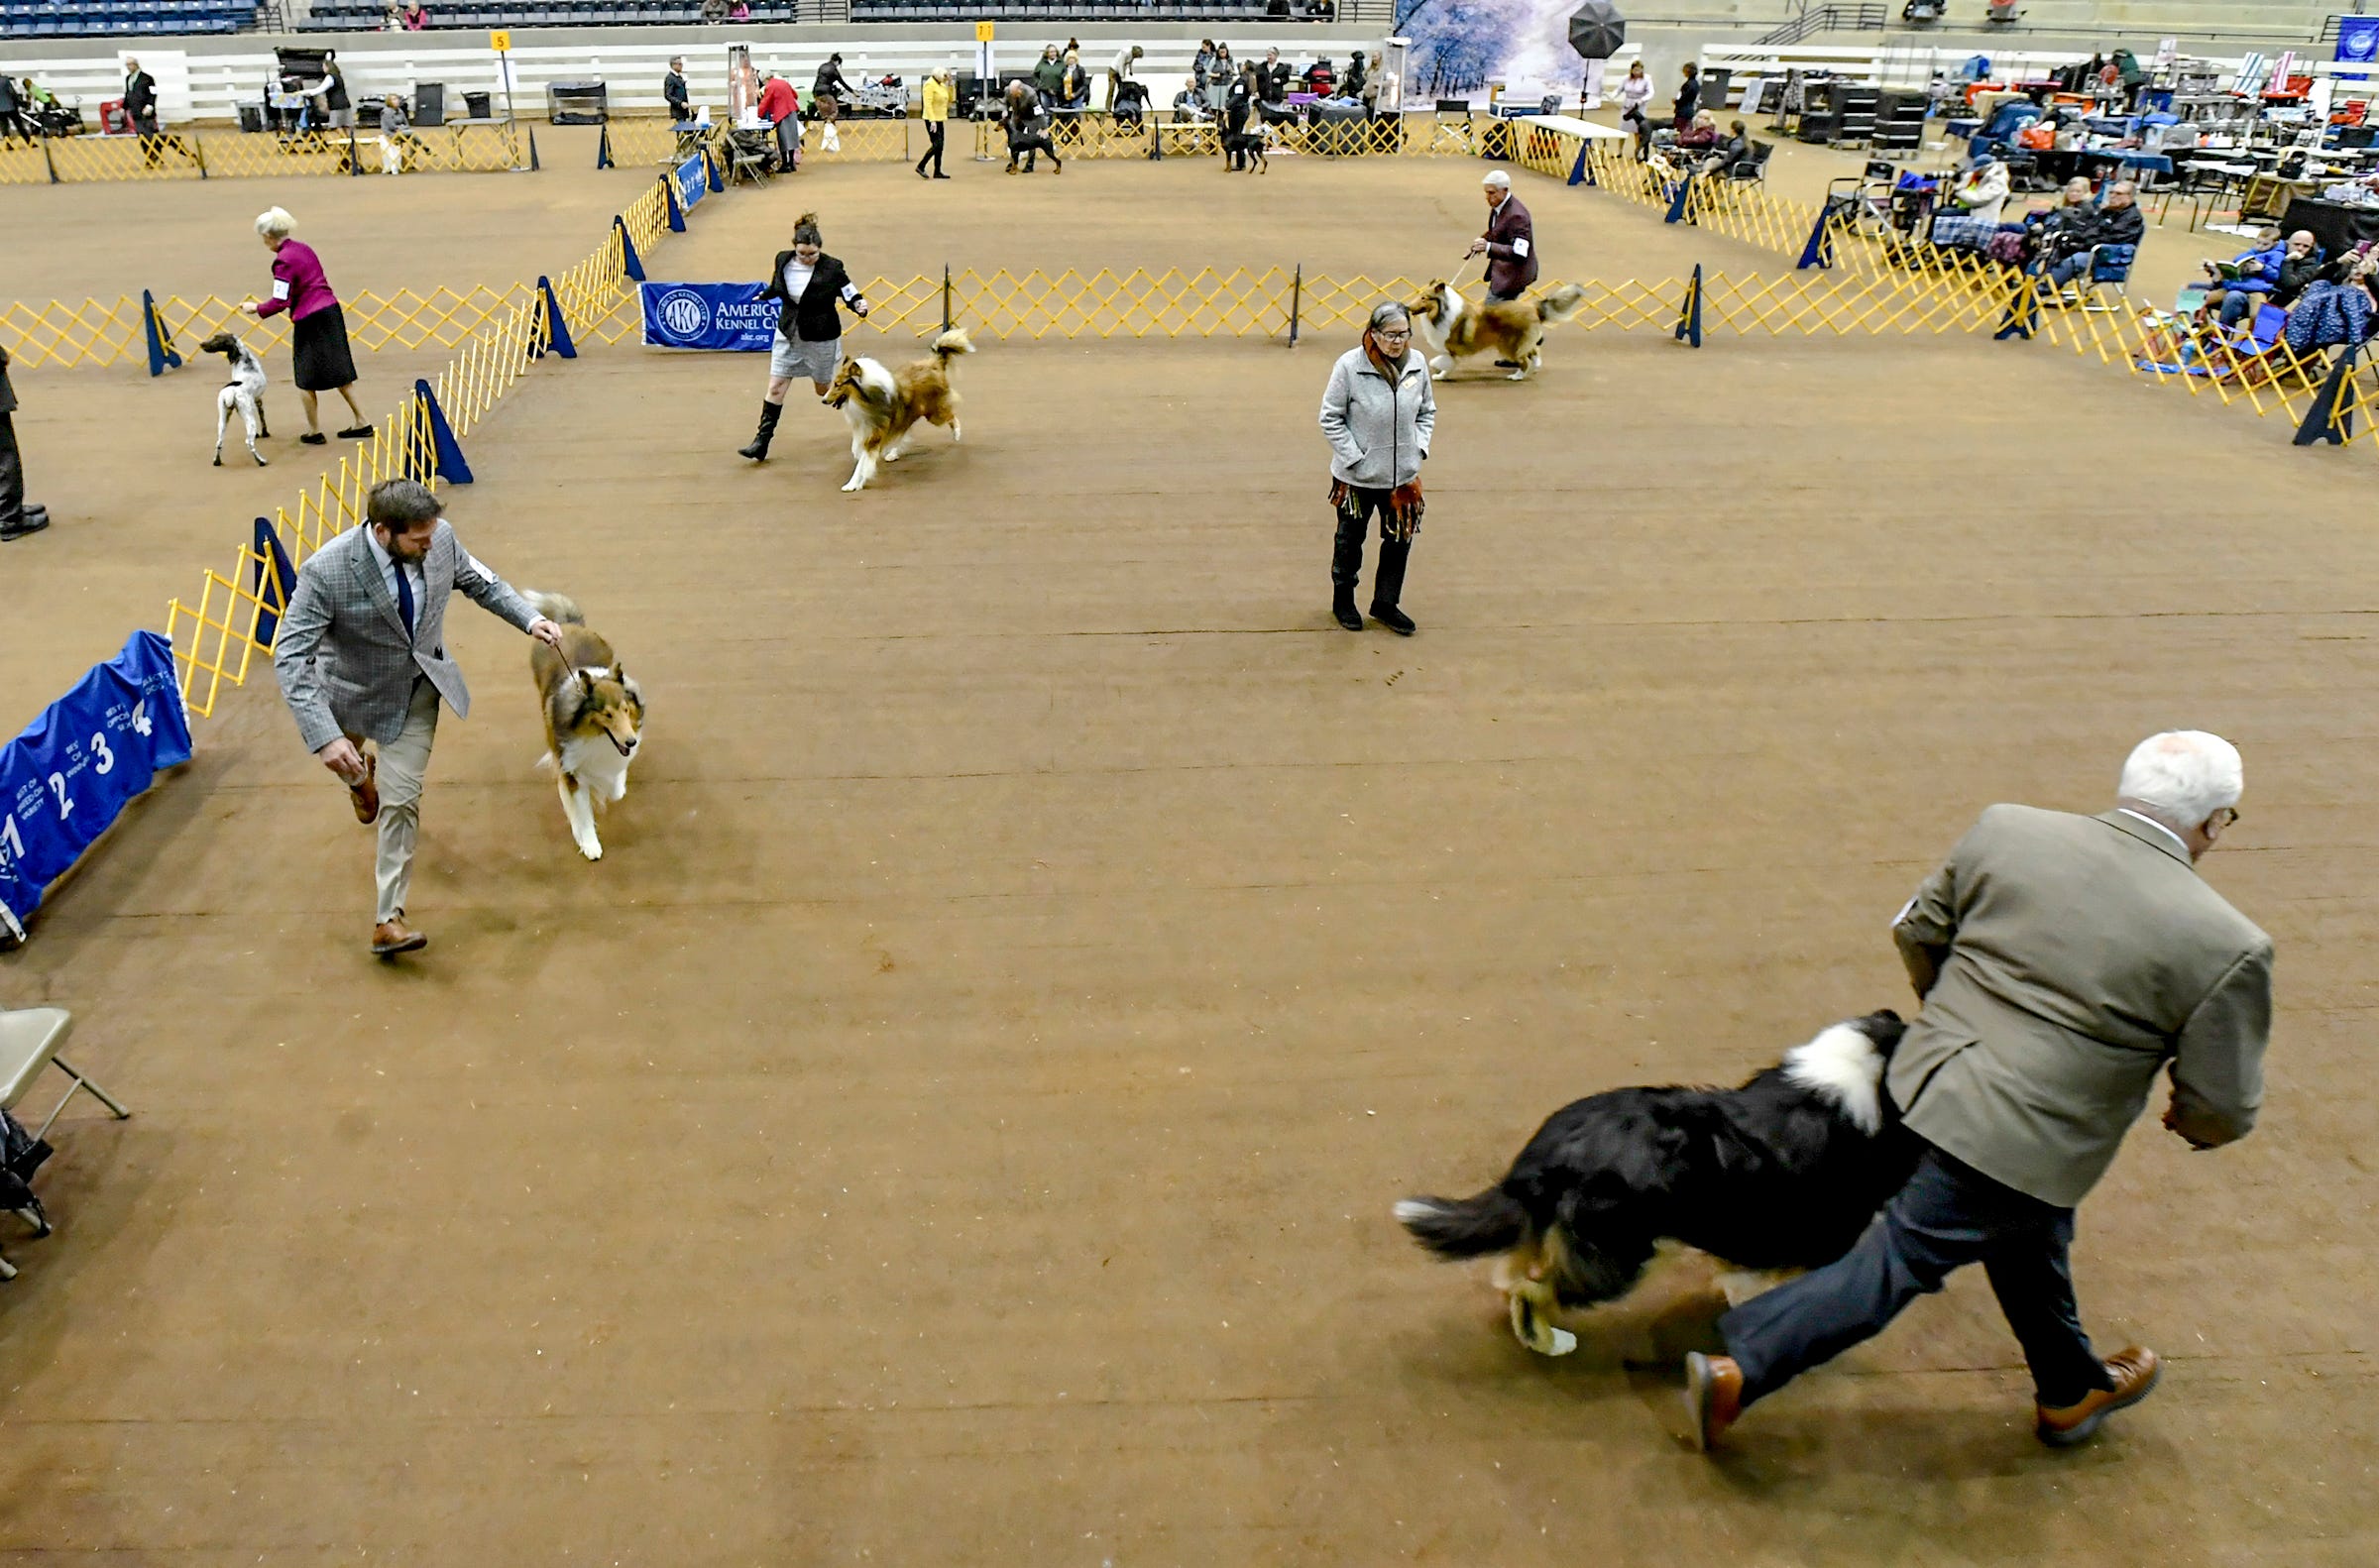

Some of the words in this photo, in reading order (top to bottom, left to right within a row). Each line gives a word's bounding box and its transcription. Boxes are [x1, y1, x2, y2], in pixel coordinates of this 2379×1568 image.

[497, 37, 505, 47] 5
[666, 299, 701, 332] AKC
[716, 317, 760, 330] KENNEL
[740, 332, 770, 343] akc.org
[132, 698, 153, 737] 4
[91, 731, 114, 775] 3
[48, 771, 74, 821] 2
